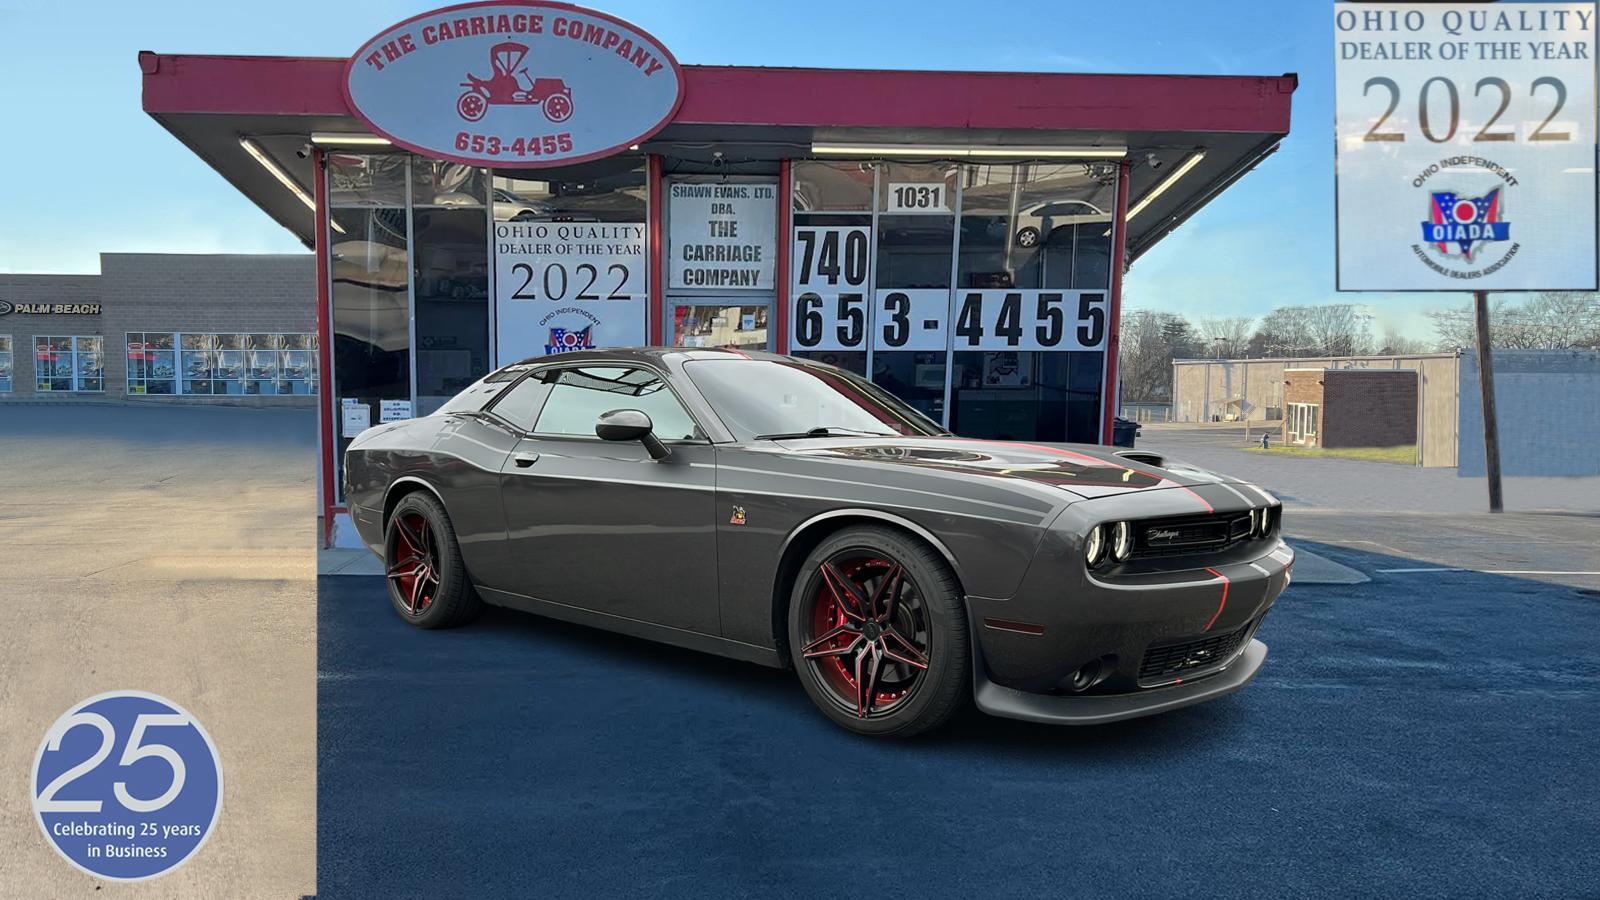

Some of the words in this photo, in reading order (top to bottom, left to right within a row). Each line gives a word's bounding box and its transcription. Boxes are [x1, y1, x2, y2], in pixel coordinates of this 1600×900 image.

[1336, 10, 1425, 31] OHIO
[1442, 10, 1593, 35] QUALITY
[366, 33, 417, 71] THE
[422, 14, 543, 45] CARRIAGE
[552, 17, 663, 77] COMPANY
[1341, 42, 1432, 60] DEALER
[1439, 42, 1469, 60] OF
[1475, 42, 1522, 60] THE
[1528, 42, 1588, 60] YEAR
[1363, 76, 1571, 143] 2022
[455, 131, 573, 156] 653-4455
[1412, 164, 1440, 188] OHIO
[1440, 156, 1519, 187] INDEPENDENT
[673, 186, 712, 198] SHAWN
[714, 186, 750, 199] EVANS.
[754, 187, 775, 199] LTD.
[894, 187, 940, 208] 1031
[711, 203, 736, 215] DBA.
[497, 226, 548, 239] OHIO
[557, 226, 644, 241] QUALITY
[708, 220, 738, 238] THE
[1432, 224, 1495, 241] OIADA
[500, 243, 552, 255] DEALER
[556, 244, 573, 255] OF
[576, 244, 603, 255] THE
[607, 244, 641, 255] YEAR
[683, 244, 762, 262] CARRIAGE
[797, 230, 868, 286] 740
[511, 262, 631, 301] 2022
[683, 268, 761, 286] COMPANY
[1449, 270, 1482, 279] DEALERS
[14, 303, 51, 314] PALM
[54, 304, 100, 314] BEACH
